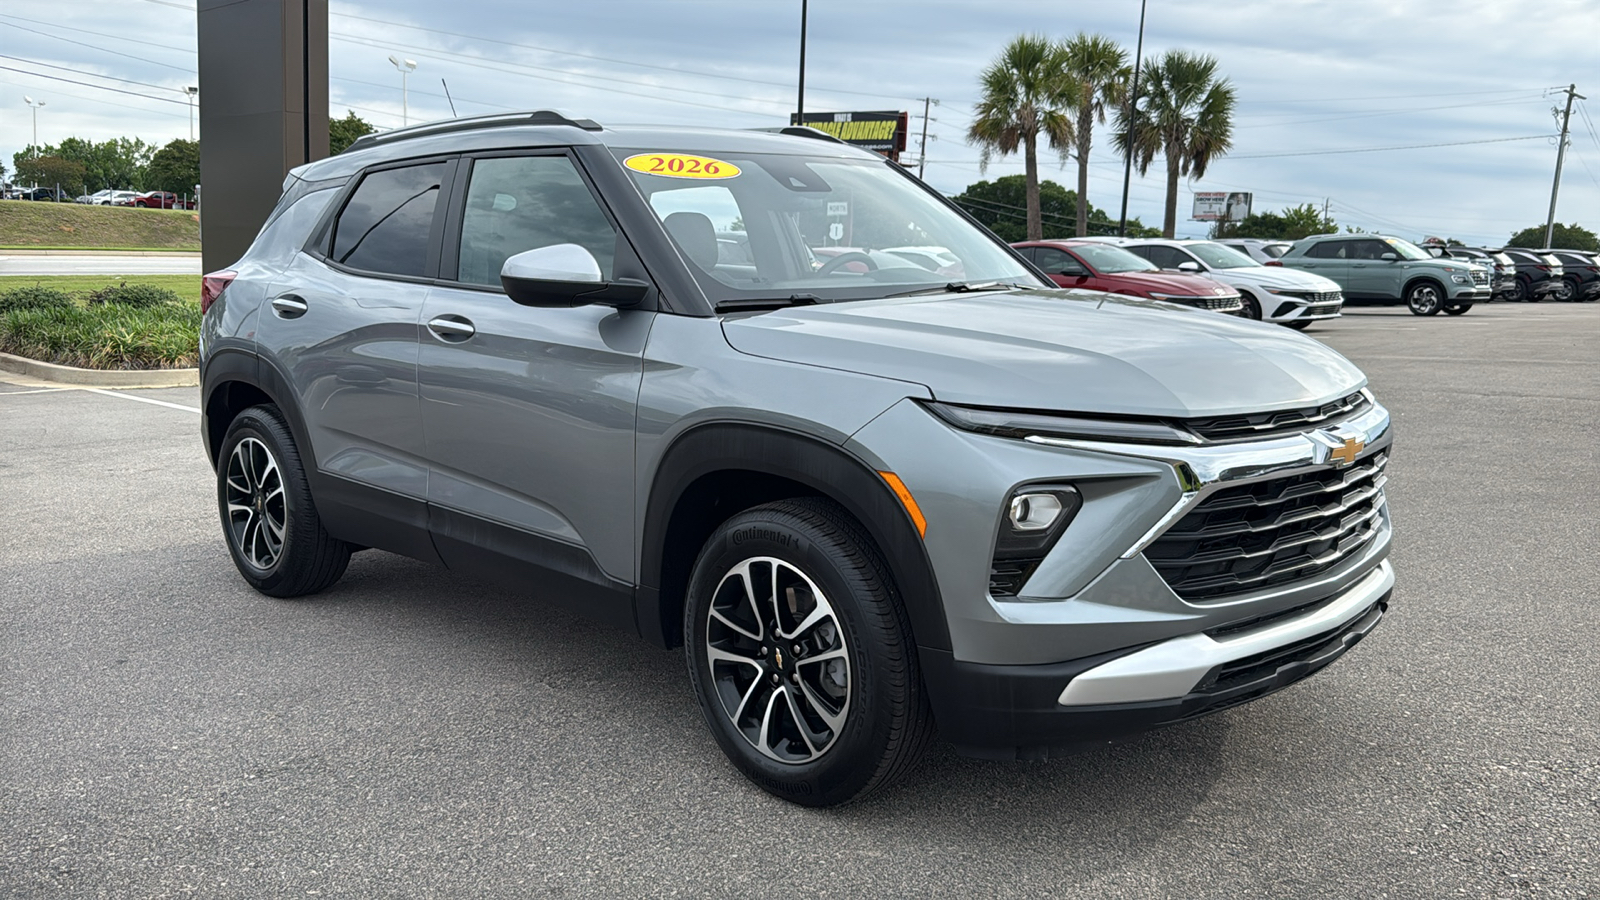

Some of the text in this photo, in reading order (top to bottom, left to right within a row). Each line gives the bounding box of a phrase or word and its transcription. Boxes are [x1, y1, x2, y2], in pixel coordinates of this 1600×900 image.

[841, 121, 897, 140] ADVANTAGE?
[649, 157, 720, 175] 2026
[732, 526, 792, 547] Continental
